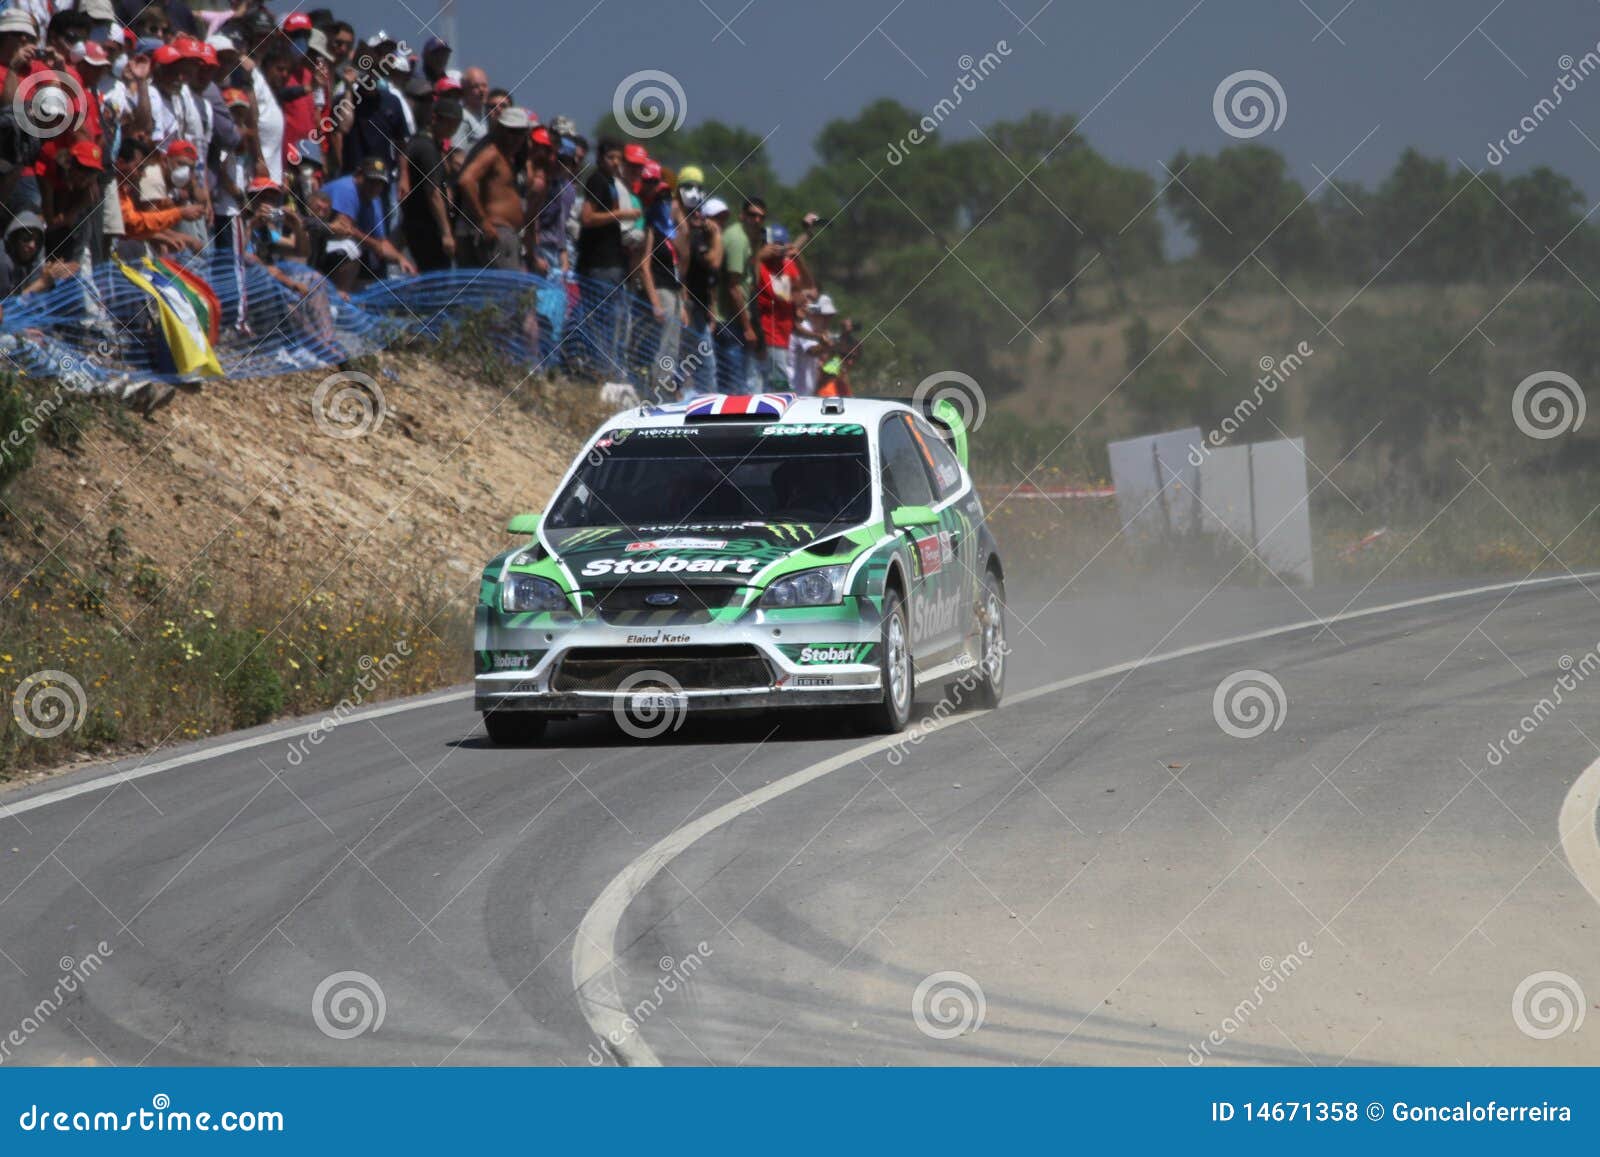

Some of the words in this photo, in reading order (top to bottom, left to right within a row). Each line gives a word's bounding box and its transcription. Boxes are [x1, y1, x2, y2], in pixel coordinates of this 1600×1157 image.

[762, 426, 836, 436] Stobart
[581, 556, 759, 576] Stobart
[662, 634, 690, 642] Katie
[800, 647, 855, 662] Stobart
